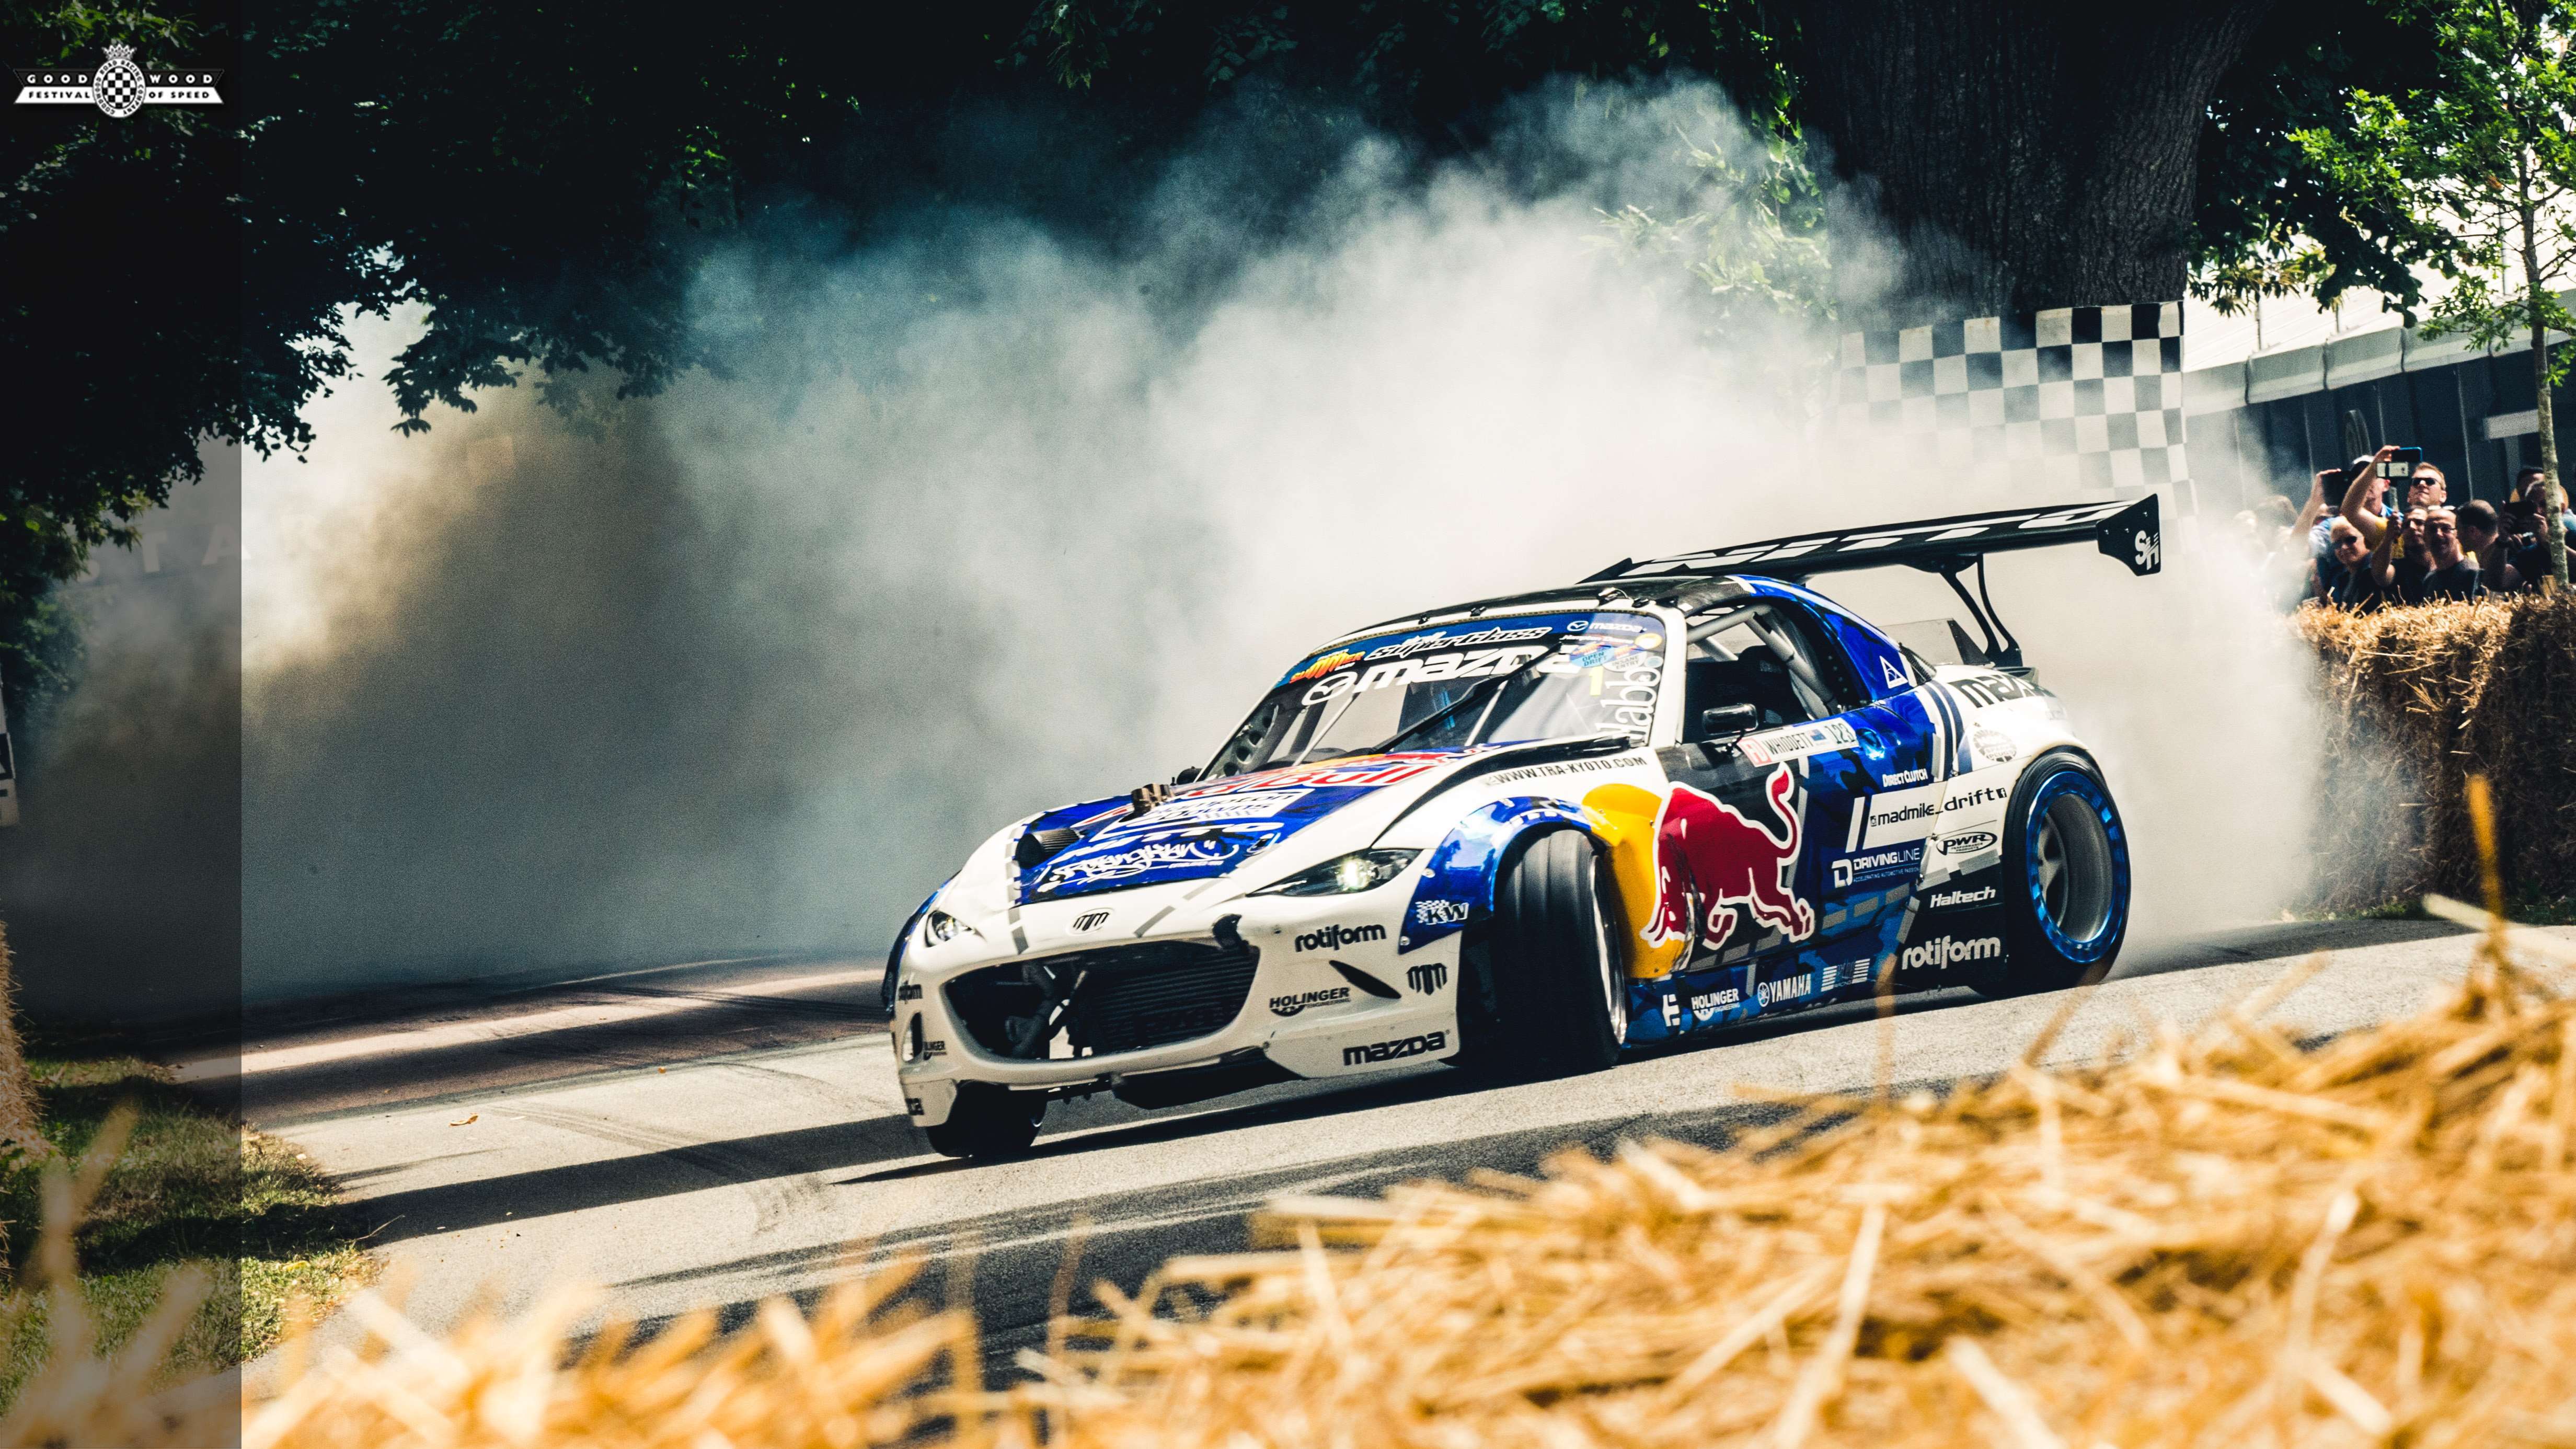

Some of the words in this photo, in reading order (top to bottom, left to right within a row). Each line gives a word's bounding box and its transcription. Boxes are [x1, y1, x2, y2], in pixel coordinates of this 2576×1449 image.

[1878, 788, 1995, 826] madmike_drift
[1942, 834, 1987, 856] PWR
[1930, 886, 1996, 908] Haltech
[1425, 902, 1469, 925] KW
[1294, 924, 1387, 953] rotiform
[1902, 935, 2001, 970] rotiform
[1269, 987, 1350, 1008] HOLINGER
[1691, 988, 1740, 1009] HOLINGER
[1769, 973, 1811, 1003] YAMAHA
